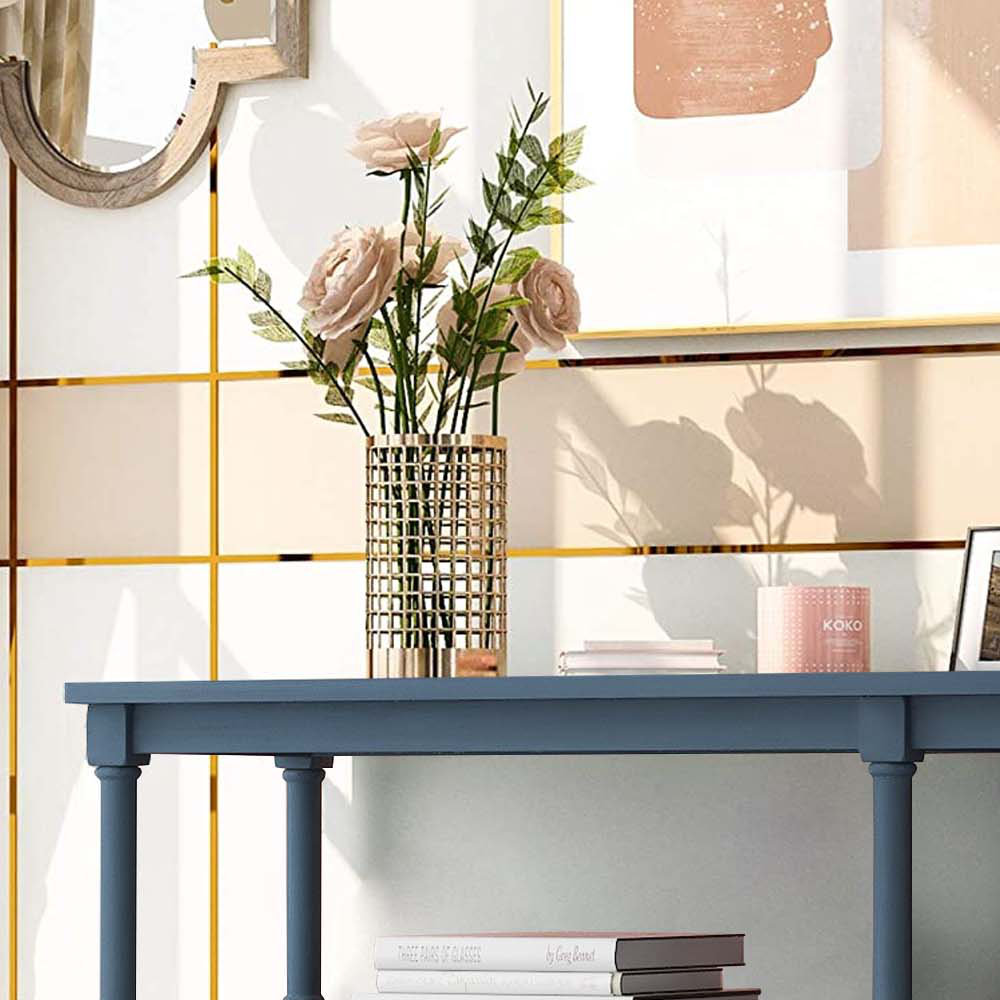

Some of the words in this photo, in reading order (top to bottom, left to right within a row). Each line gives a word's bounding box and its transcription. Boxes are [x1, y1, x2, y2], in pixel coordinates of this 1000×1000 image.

[823, 619, 863, 632] KOKO
[398, 944, 418, 961] THREE
[453, 945, 481, 963] GLASSES
